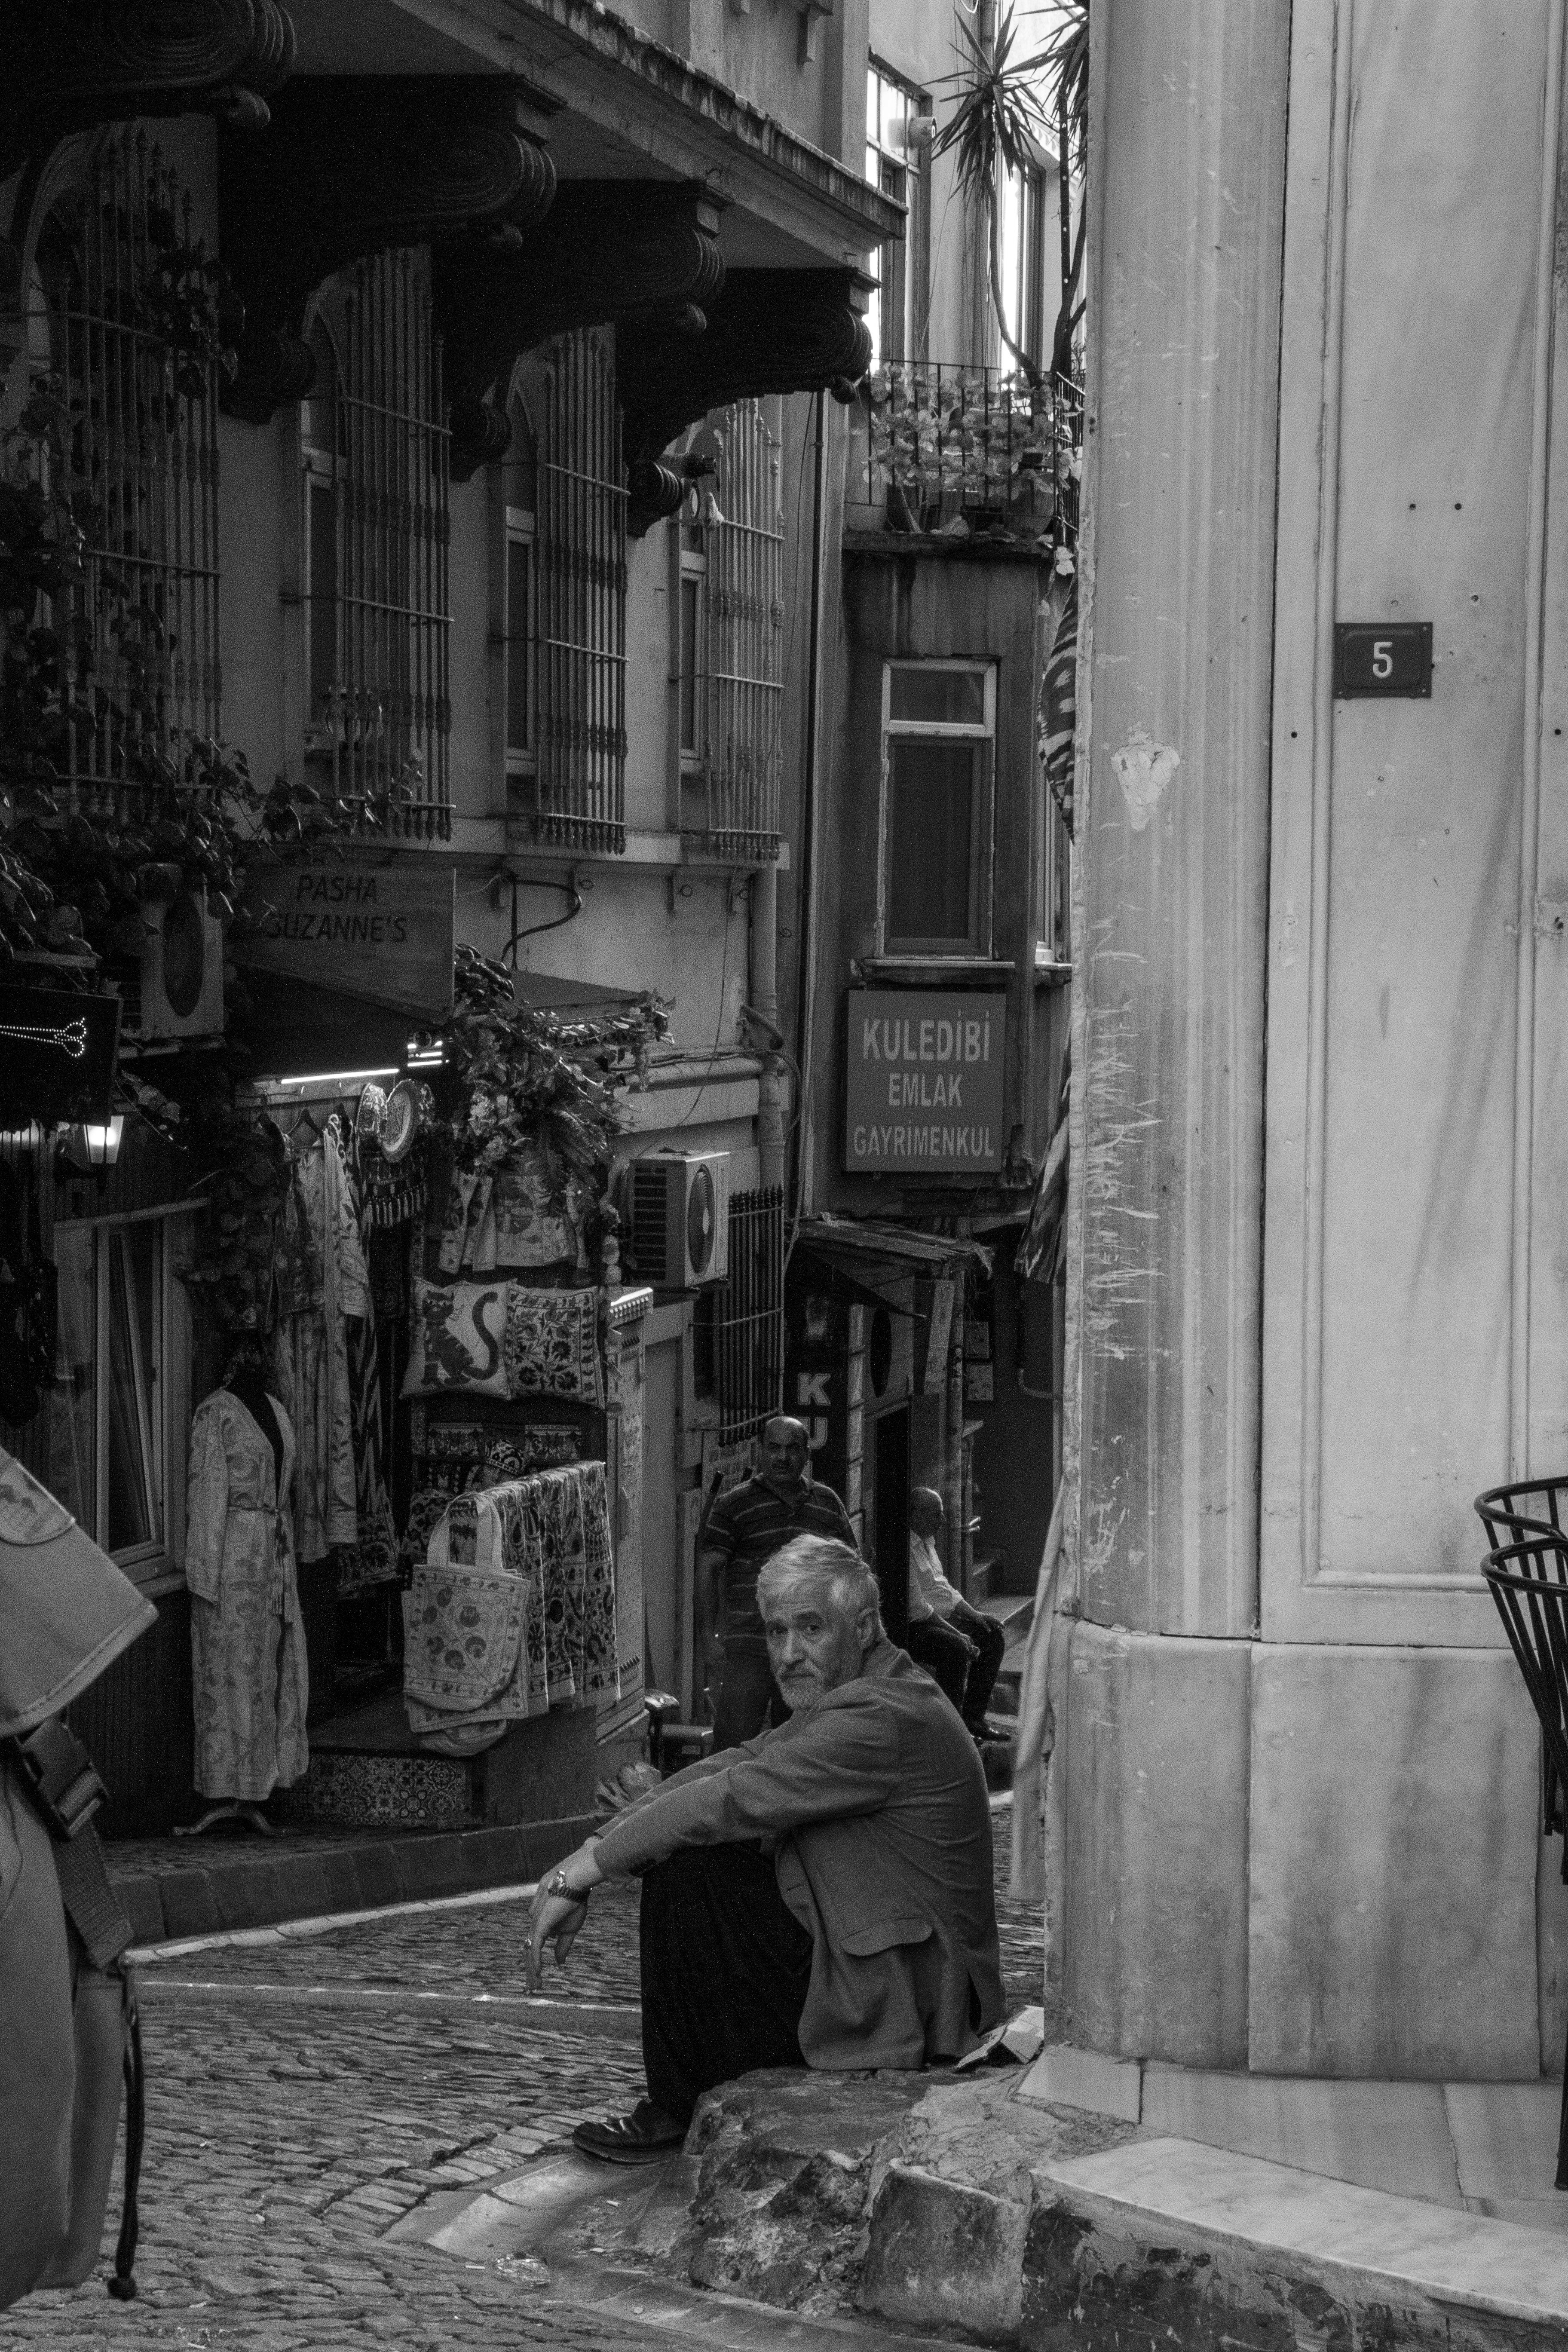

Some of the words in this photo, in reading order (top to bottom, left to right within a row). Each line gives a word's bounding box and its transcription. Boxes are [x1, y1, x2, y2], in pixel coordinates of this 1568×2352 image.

[1373, 642, 1393, 679] 5
[297, 875, 377, 903] PASHA
[266, 913, 408, 943] SUZANNE'S
[862, 1009, 990, 1062] KULEDİBİ
[888, 1072, 963, 1107] EMLAK
[853, 1119, 995, 1158] GAYRİMENKUL
